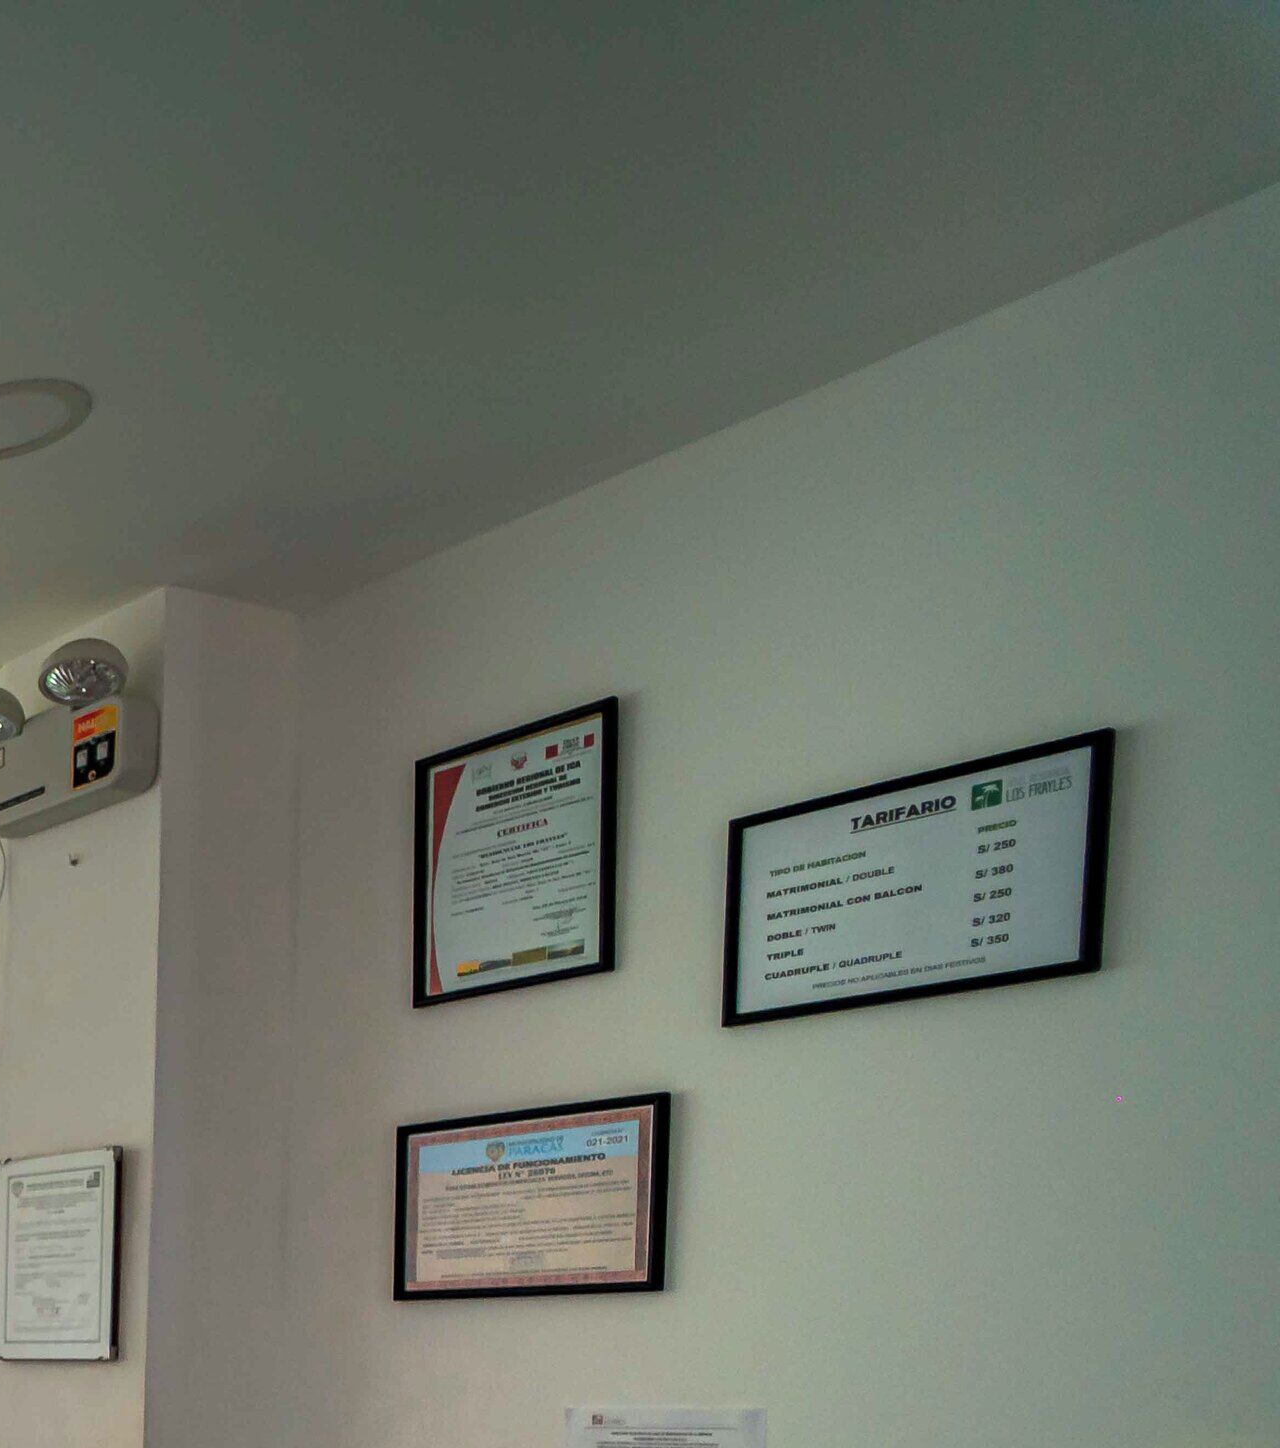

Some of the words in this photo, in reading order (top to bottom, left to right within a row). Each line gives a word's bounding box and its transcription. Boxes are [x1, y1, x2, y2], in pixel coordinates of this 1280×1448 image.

[1028, 775, 1073, 800] FRAYLES
[851, 796, 957, 831] TARIFARIO
[978, 819, 1017, 834] PRECIO
[994, 838, 1016, 851] 250
[769, 867, 791, 878] TIPO
[792, 864, 805, 873] DE
[807, 851, 866, 870] HABITACION
[991, 863, 1014, 876] 380
[766, 877, 843, 899] MATRIMONIAL
[852, 866, 895, 882] DOUBLE
[989, 887, 1012, 900] 250
[766, 899, 843, 921] MATRIMONIAL
[846, 894, 871, 906] CON
[874, 884, 923, 900] BALCON
[988, 912, 1011, 924] 320
[767, 929, 802, 942] DOBLE
[811, 923, 836, 934] TWIN
[986, 933, 1009, 945] 350
[766, 948, 804, 961] TRIPLE
[764, 963, 830, 981] CUADRUPLE
[838, 950, 903, 969] QUADRUPLE
[586, 1135, 629, 1147] 021-2021
[452, 1164, 496, 1176] LICENCIA
[512, 1152, 606, 1169] FUNCIONAMIENTO
